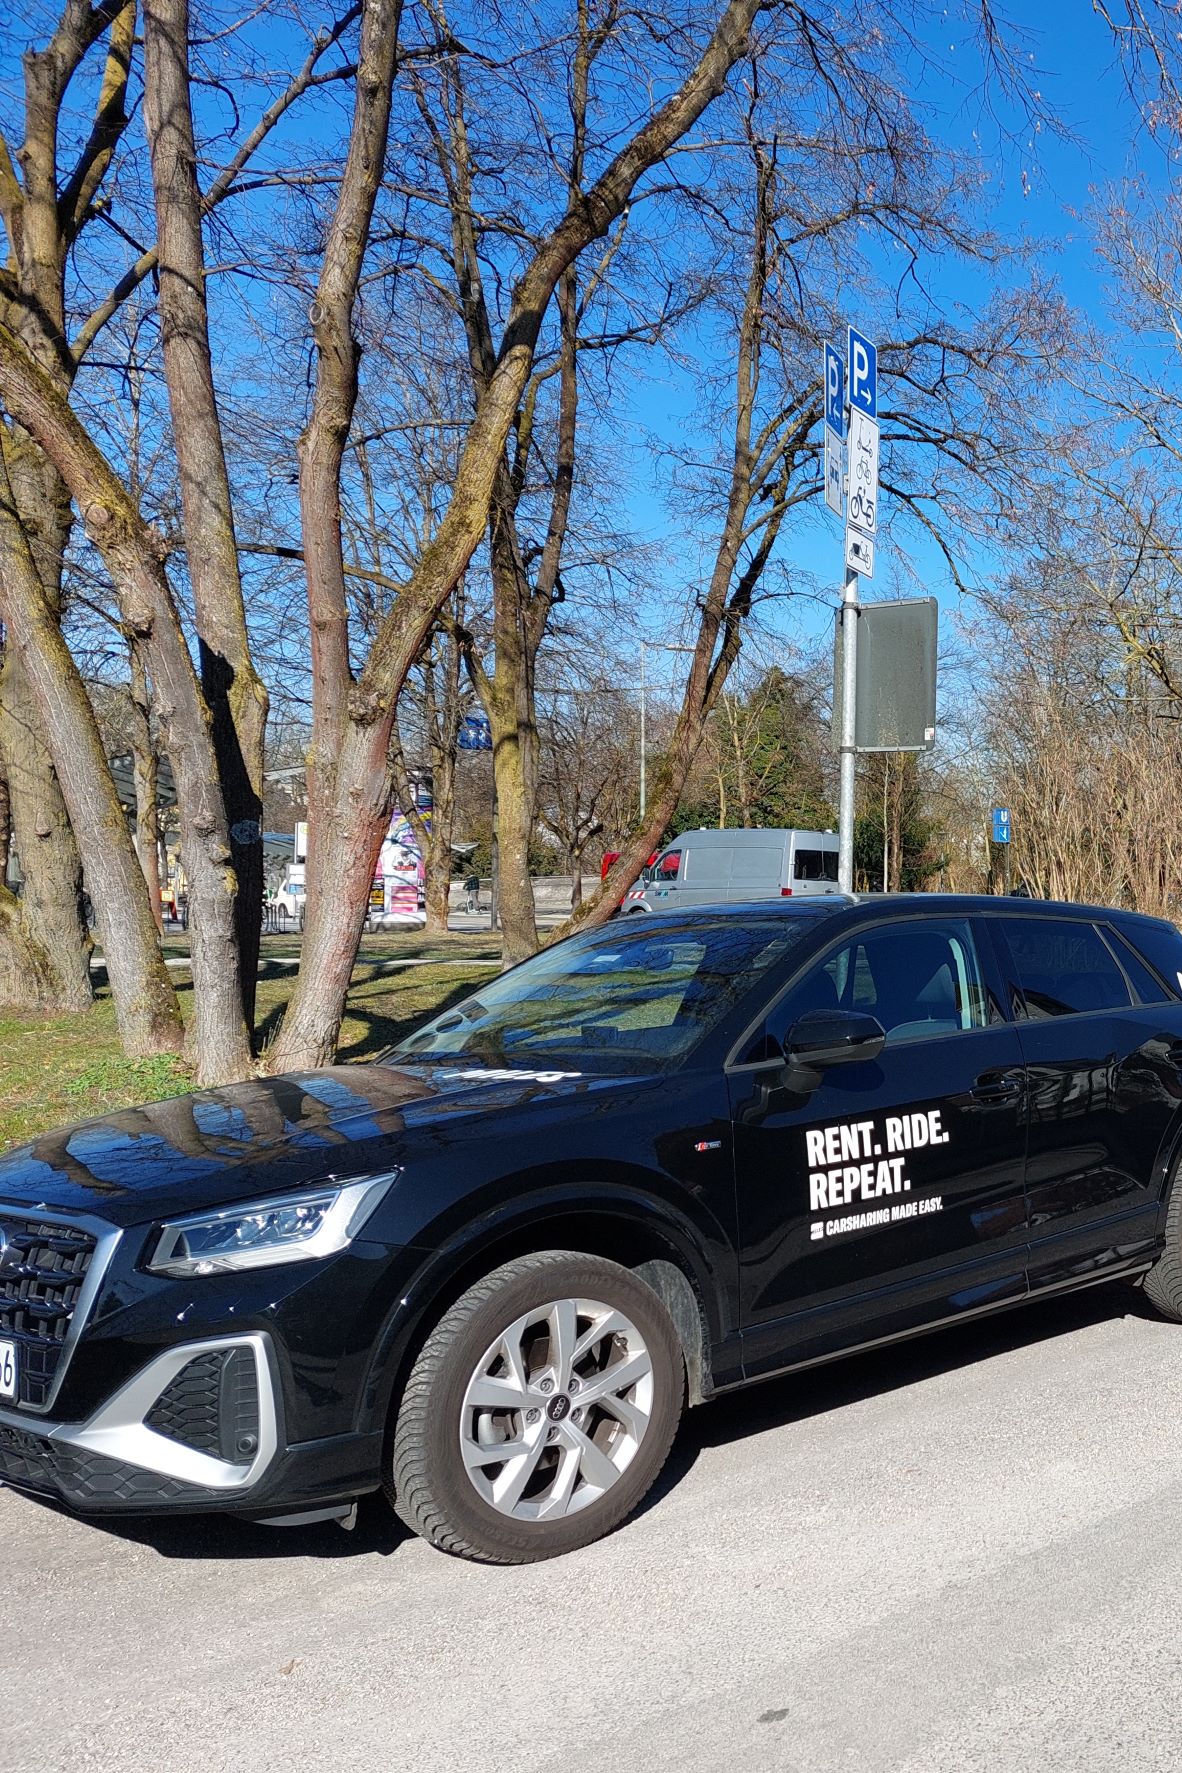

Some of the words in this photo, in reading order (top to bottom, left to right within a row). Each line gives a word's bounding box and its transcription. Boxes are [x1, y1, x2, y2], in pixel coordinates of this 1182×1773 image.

[853, 340, 869, 398] P
[1000, 810, 1008, 823] U
[806, 1121, 881, 1167] RENT.
[886, 1110, 949, 1153] RIDE.
[809, 1157, 911, 1211] REPEAT.
[826, 1208, 890, 1236] CARSHARING
[891, 1203, 918, 1220] MADE
[918, 1196, 943, 1215] EASY.
[0, 1350, 12, 1388] 6
